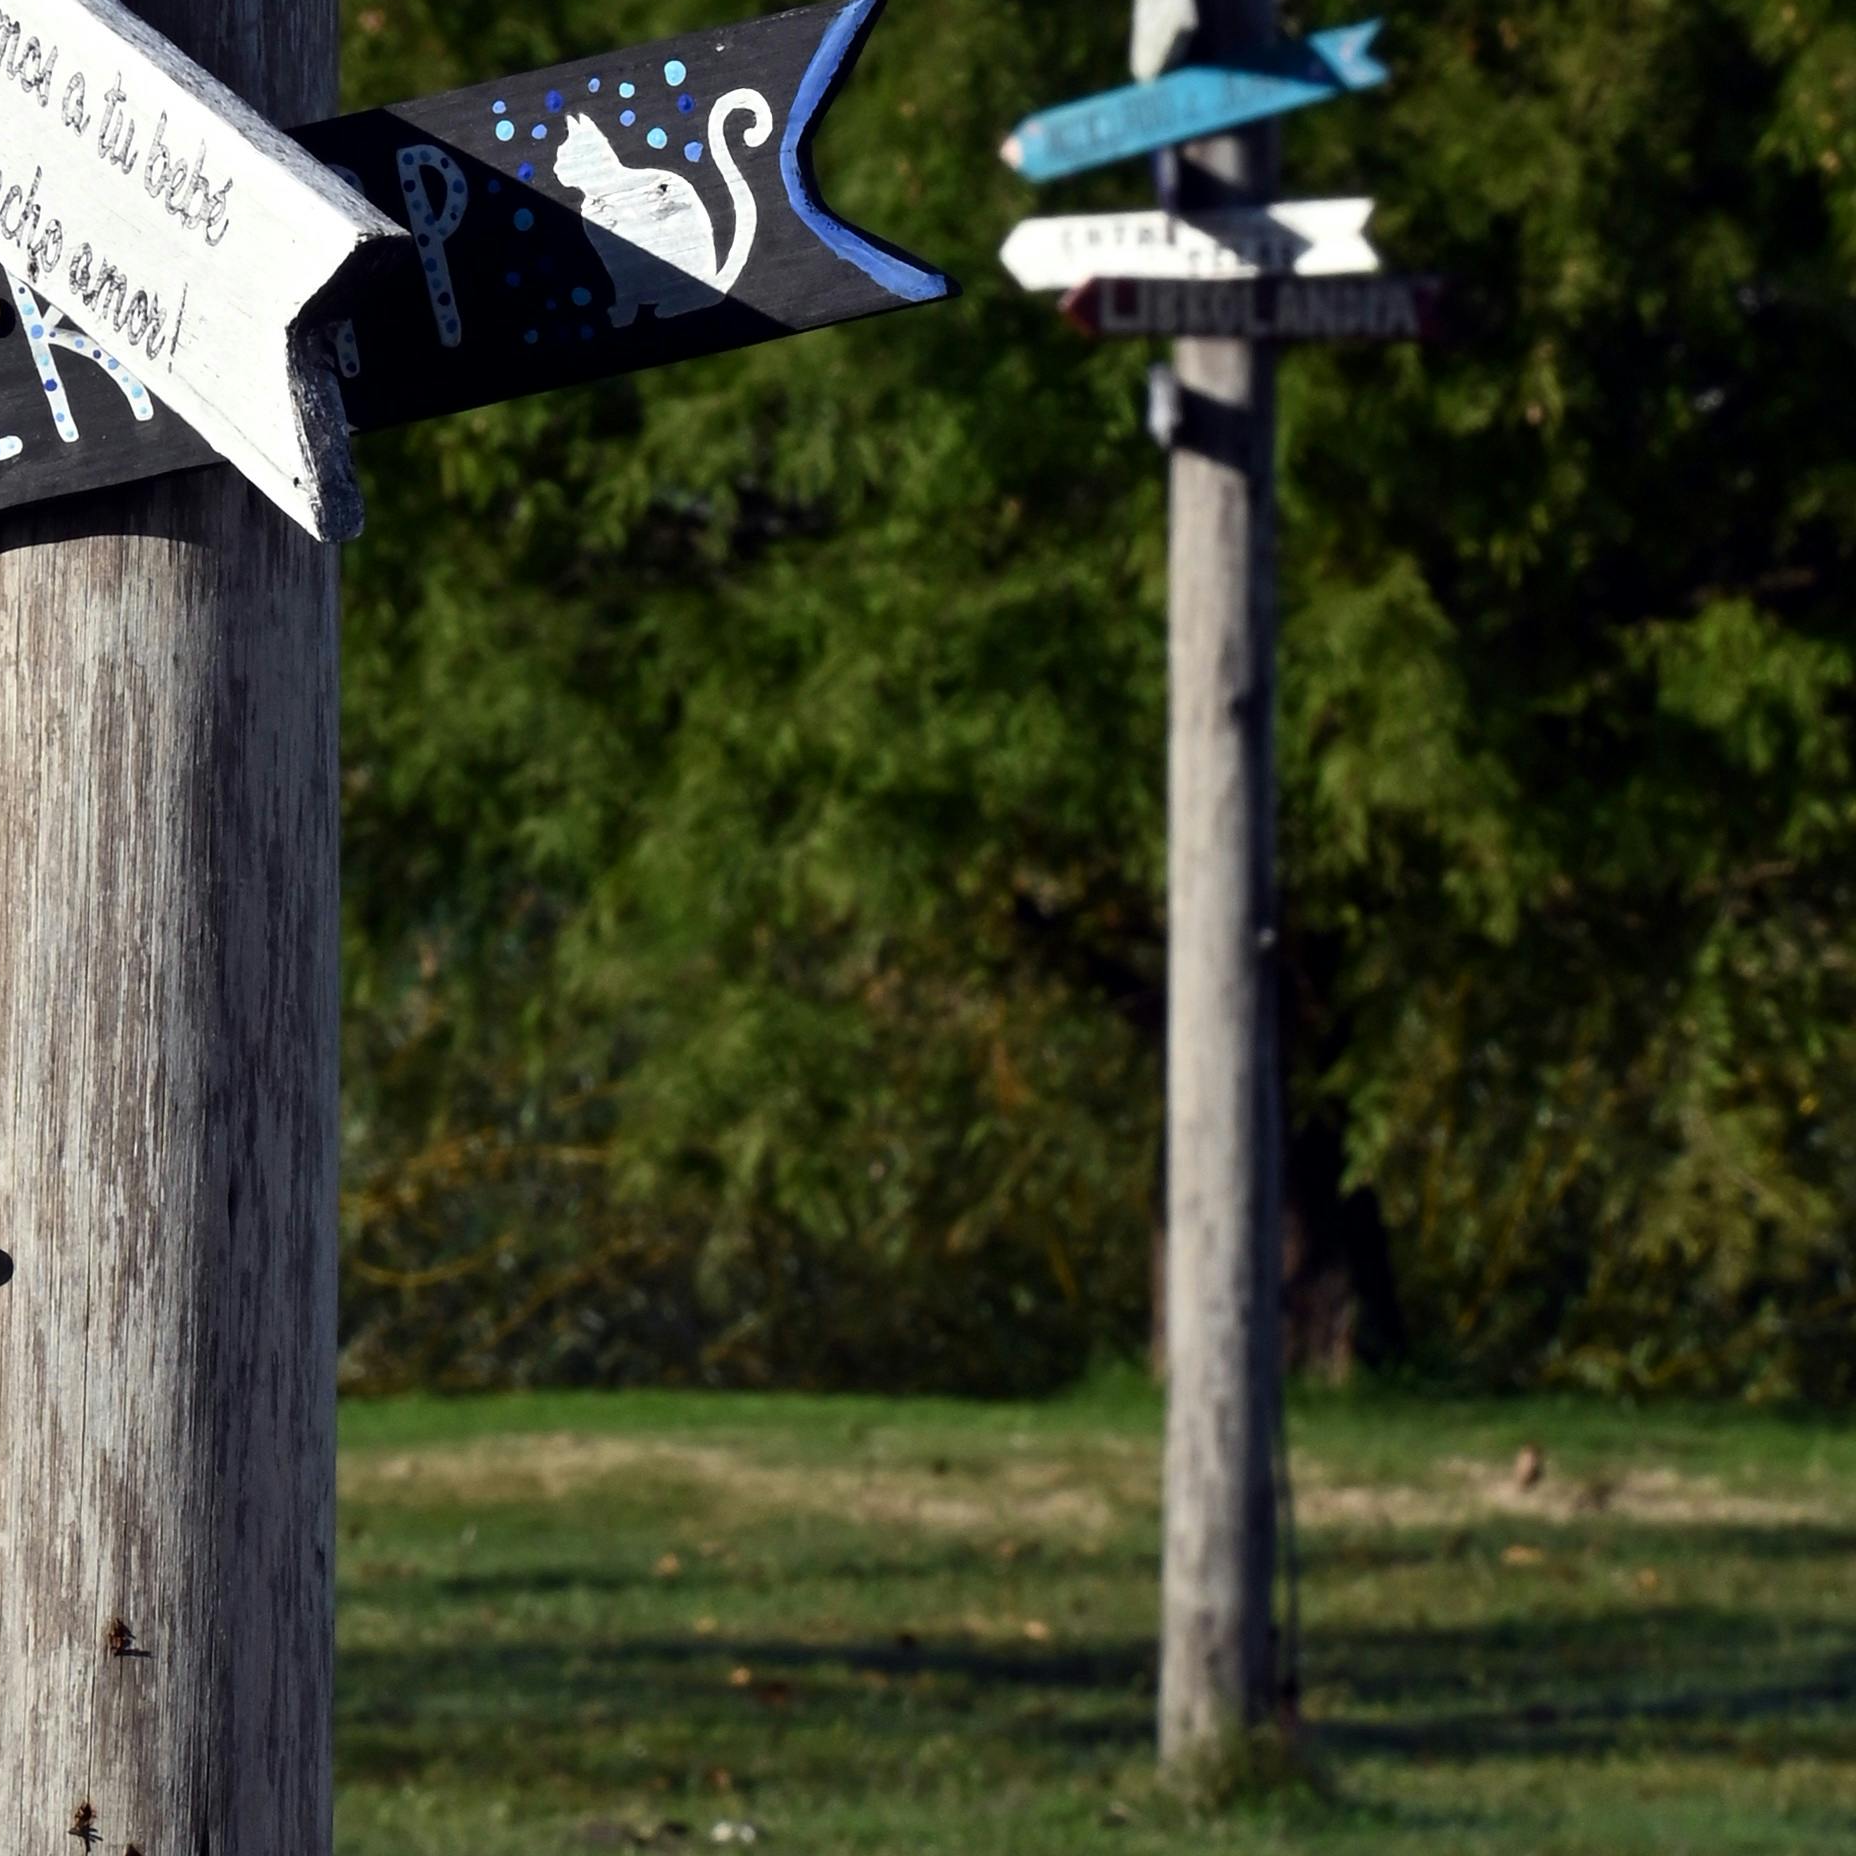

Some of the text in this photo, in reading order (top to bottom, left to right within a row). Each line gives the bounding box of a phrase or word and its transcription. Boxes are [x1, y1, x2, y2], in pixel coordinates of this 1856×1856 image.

[62, 70, 92, 138] a
[97, 69, 140, 176] tu
[142, 109, 234, 248] bebé
[67, 241, 191, 375] amor!
